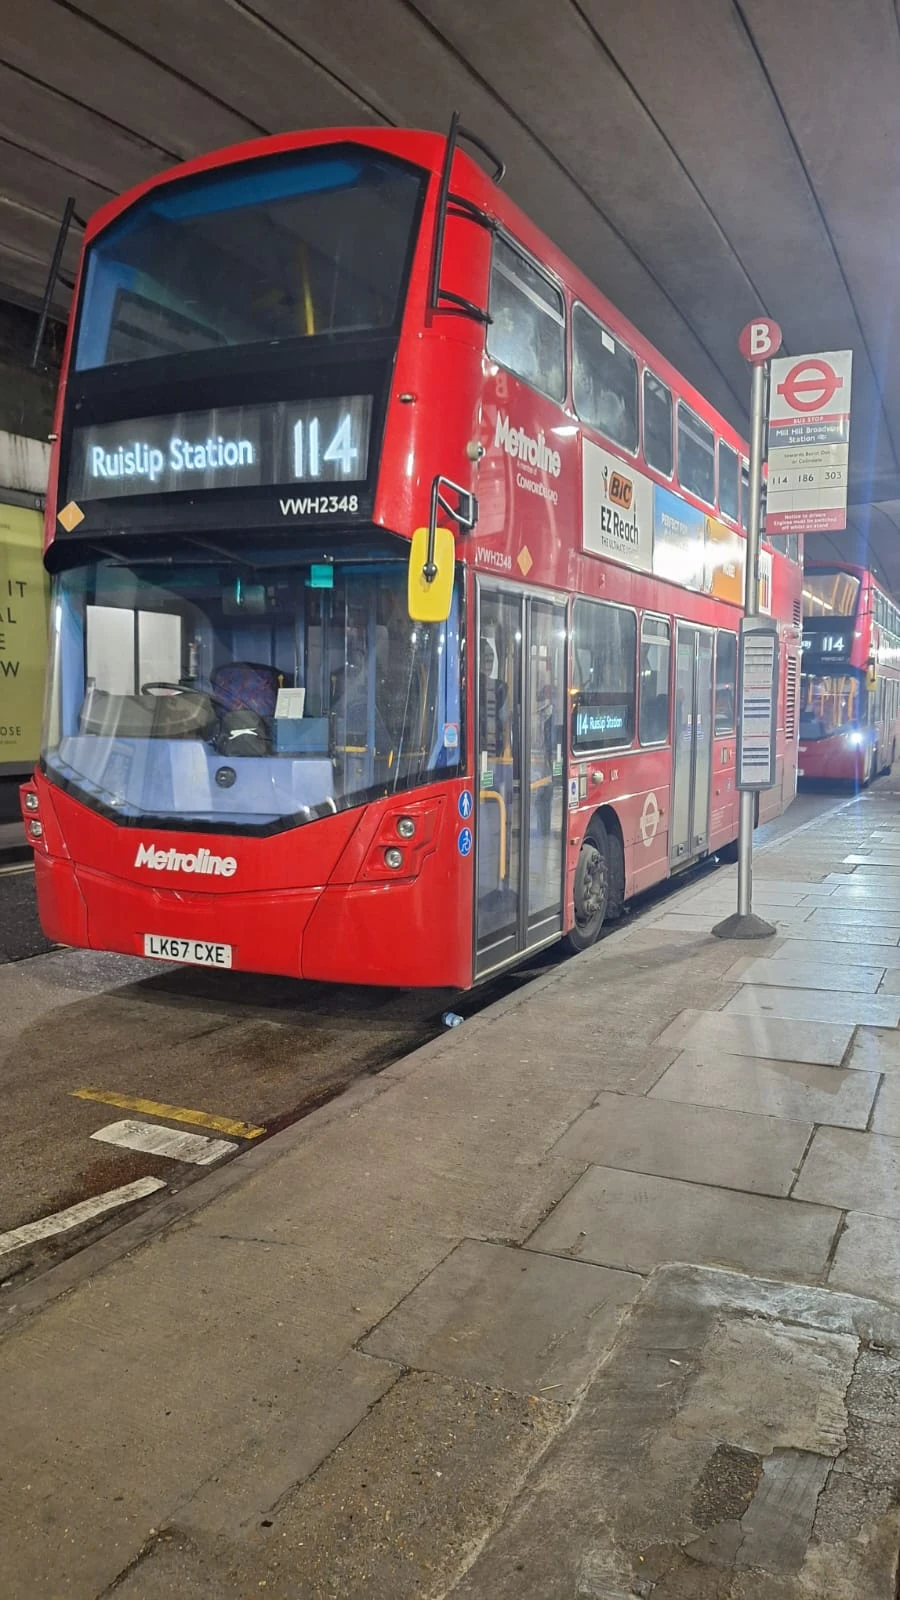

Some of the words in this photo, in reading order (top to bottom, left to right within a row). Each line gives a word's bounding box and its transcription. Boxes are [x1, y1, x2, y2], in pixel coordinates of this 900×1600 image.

[750, 323, 772, 356] B
[294, 414, 357, 477] 114
[494, 410, 562, 478] Metroline
[788, 434, 816, 444] Station
[92, 446, 163, 481] Ruislip
[170, 437, 253, 471] Station
[772, 476, 788, 485] 114
[798, 473, 814, 483] 186
[825, 470, 842, 480] 303
[610, 477, 633, 504] BIC
[279, 495, 358, 515] VWH2348
[600, 505, 612, 533] EZ
[613, 511, 640, 545] Reach
[477, 548, 512, 569] VWH2348
[8, 580, 27, 598] IT
[822, 636, 845, 652] 114
[0, 726, 21, 736] OSE
[576, 713, 588, 735] 114
[589, 716, 606, 732] Ruislip
[606, 714, 623, 729] Station
[134, 842, 238, 877] Metroline
[149, 937, 189, 958] LK67
[194, 943, 225, 963] CXE
